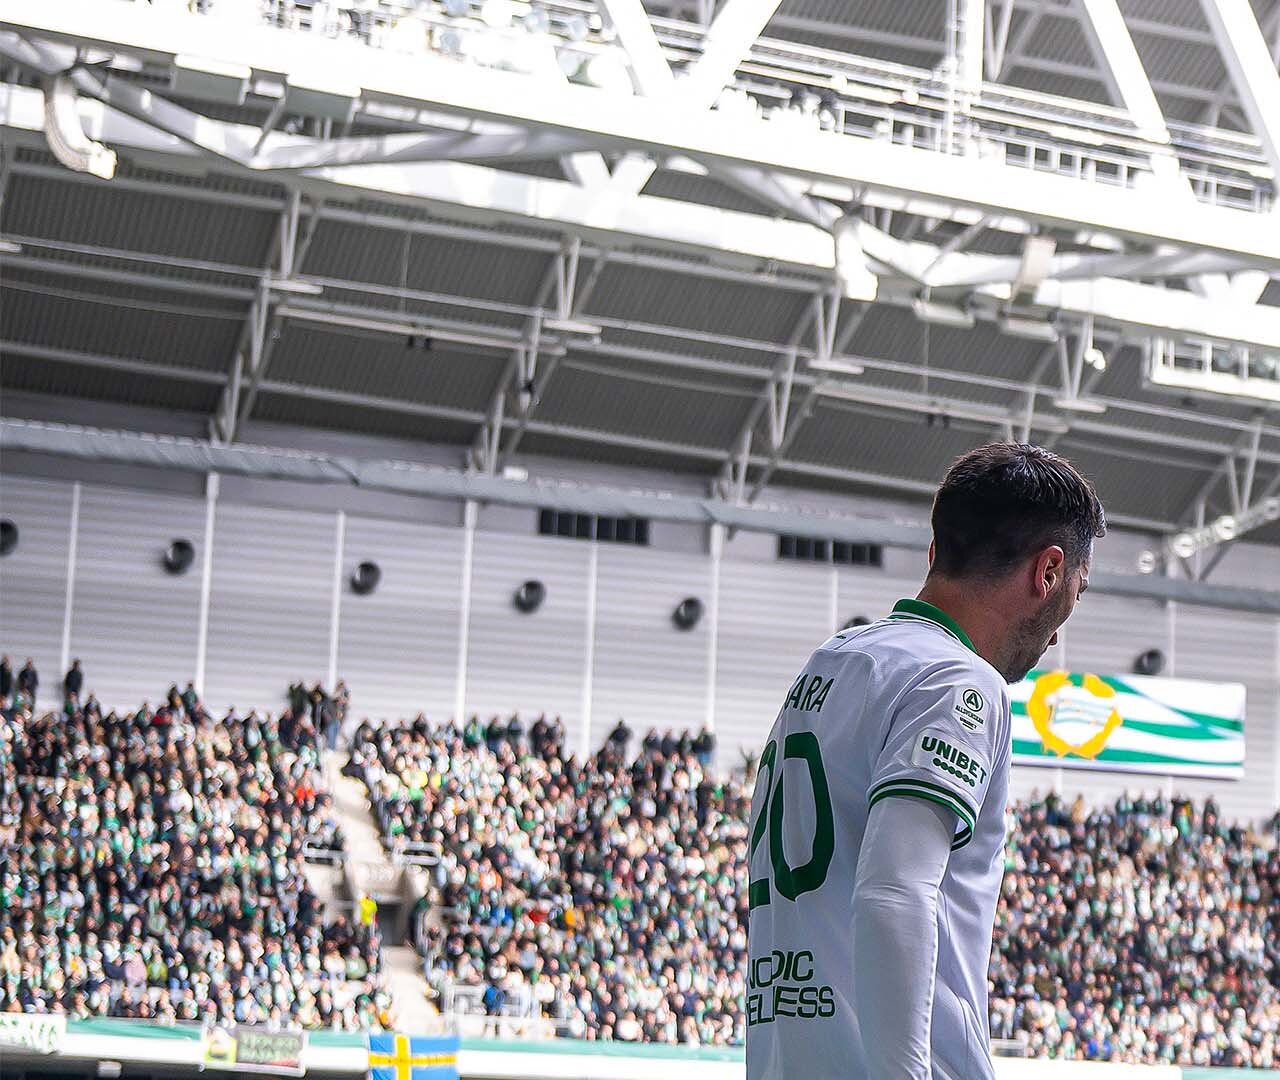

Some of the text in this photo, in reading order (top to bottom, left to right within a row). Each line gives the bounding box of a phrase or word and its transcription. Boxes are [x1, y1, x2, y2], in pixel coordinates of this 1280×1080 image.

[785, 674, 834, 712] ARA
[921, 736, 987, 784] UNIBET
[750, 732, 835, 910] 20
